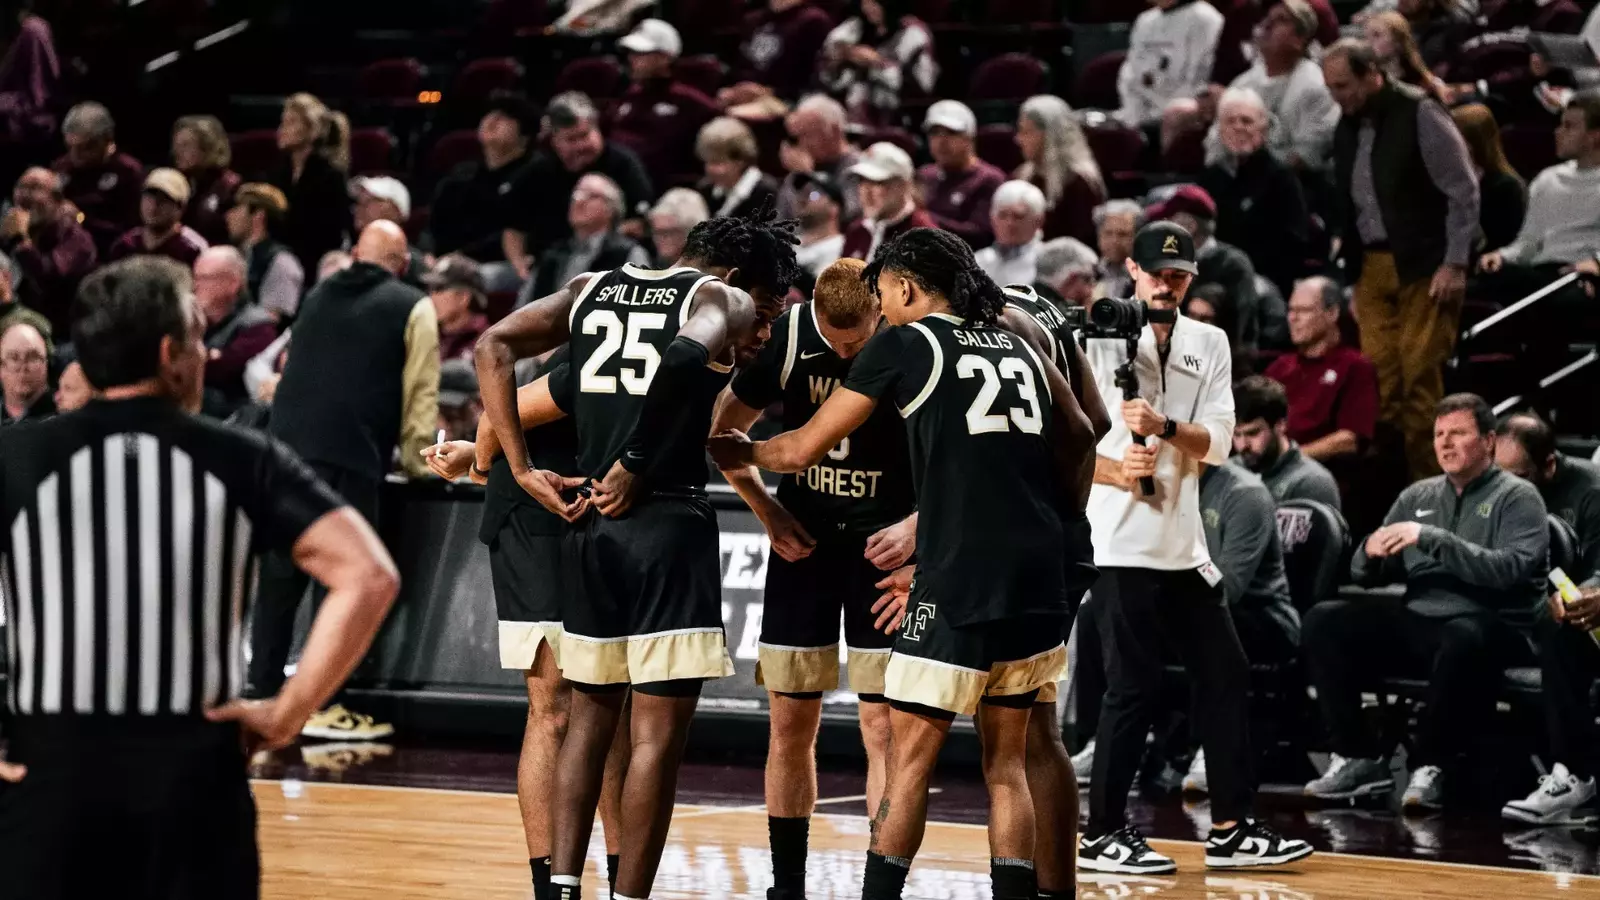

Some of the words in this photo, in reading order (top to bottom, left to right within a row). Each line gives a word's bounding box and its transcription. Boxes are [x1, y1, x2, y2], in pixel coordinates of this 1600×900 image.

[596, 284, 678, 306] SPILLERS
[953, 329, 1014, 350] SALLIS
[580, 309, 667, 396] 25
[1183, 355, 1203, 371] WF
[956, 354, 1043, 435] 23
